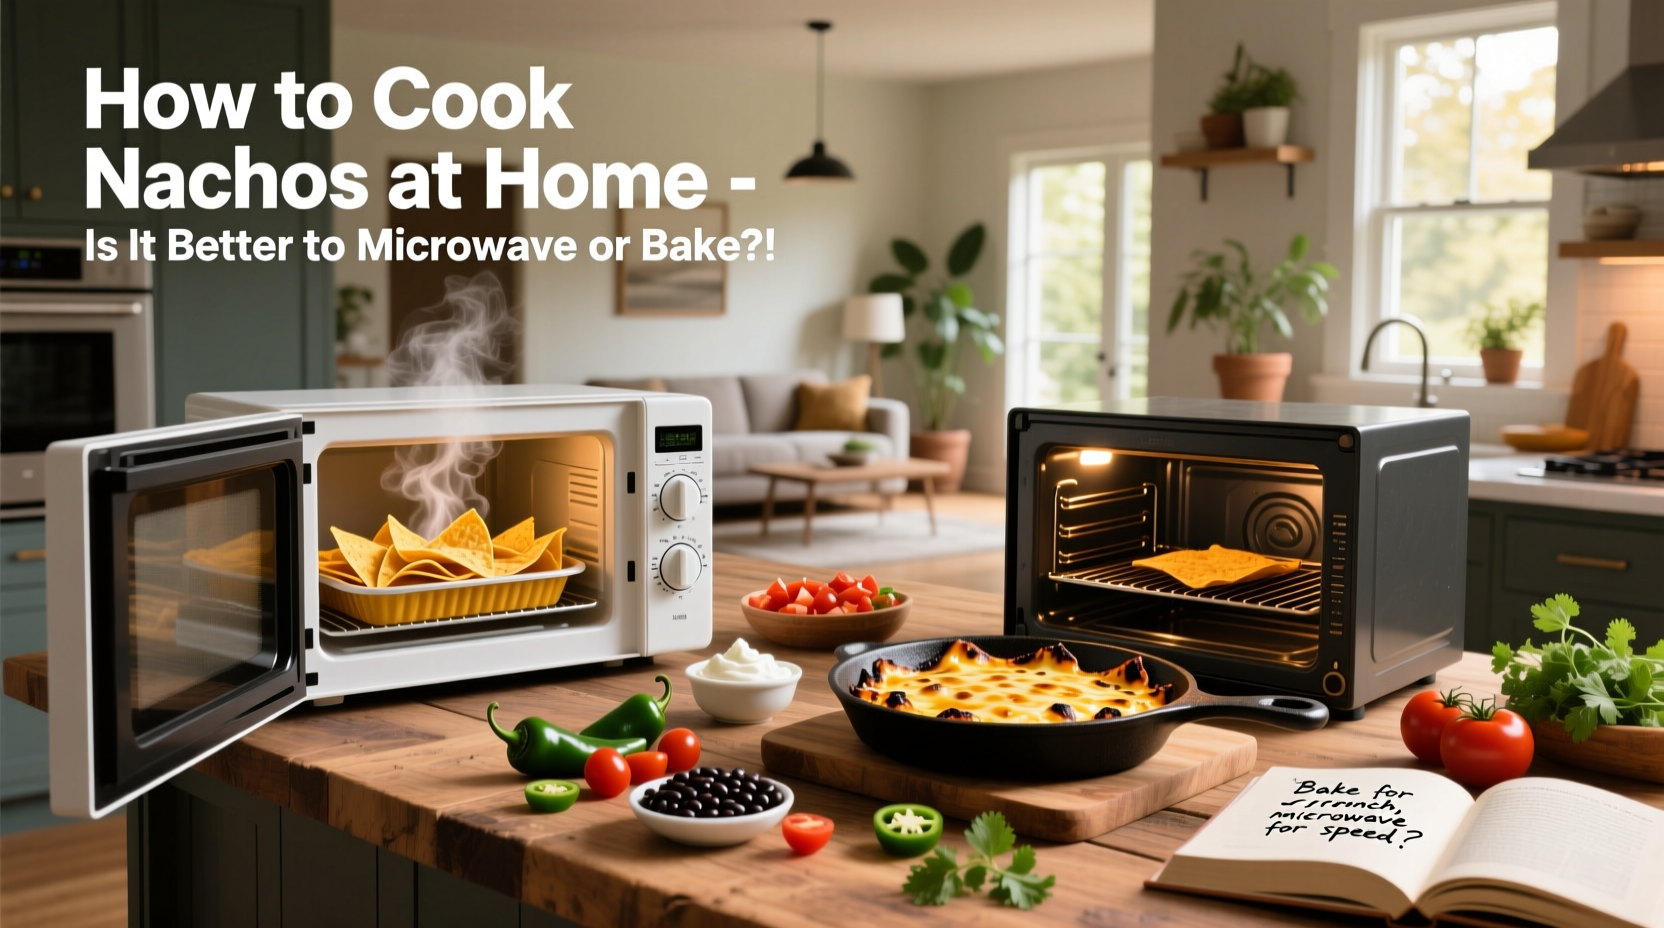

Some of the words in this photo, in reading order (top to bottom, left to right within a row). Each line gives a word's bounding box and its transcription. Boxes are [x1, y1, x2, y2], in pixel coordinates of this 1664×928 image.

[1293, 779, 1361, 796] Bake
[1372, 784, 1414, 800] for
[1265, 820, 1308, 837] for
[1319, 825, 1424, 850] speed?
